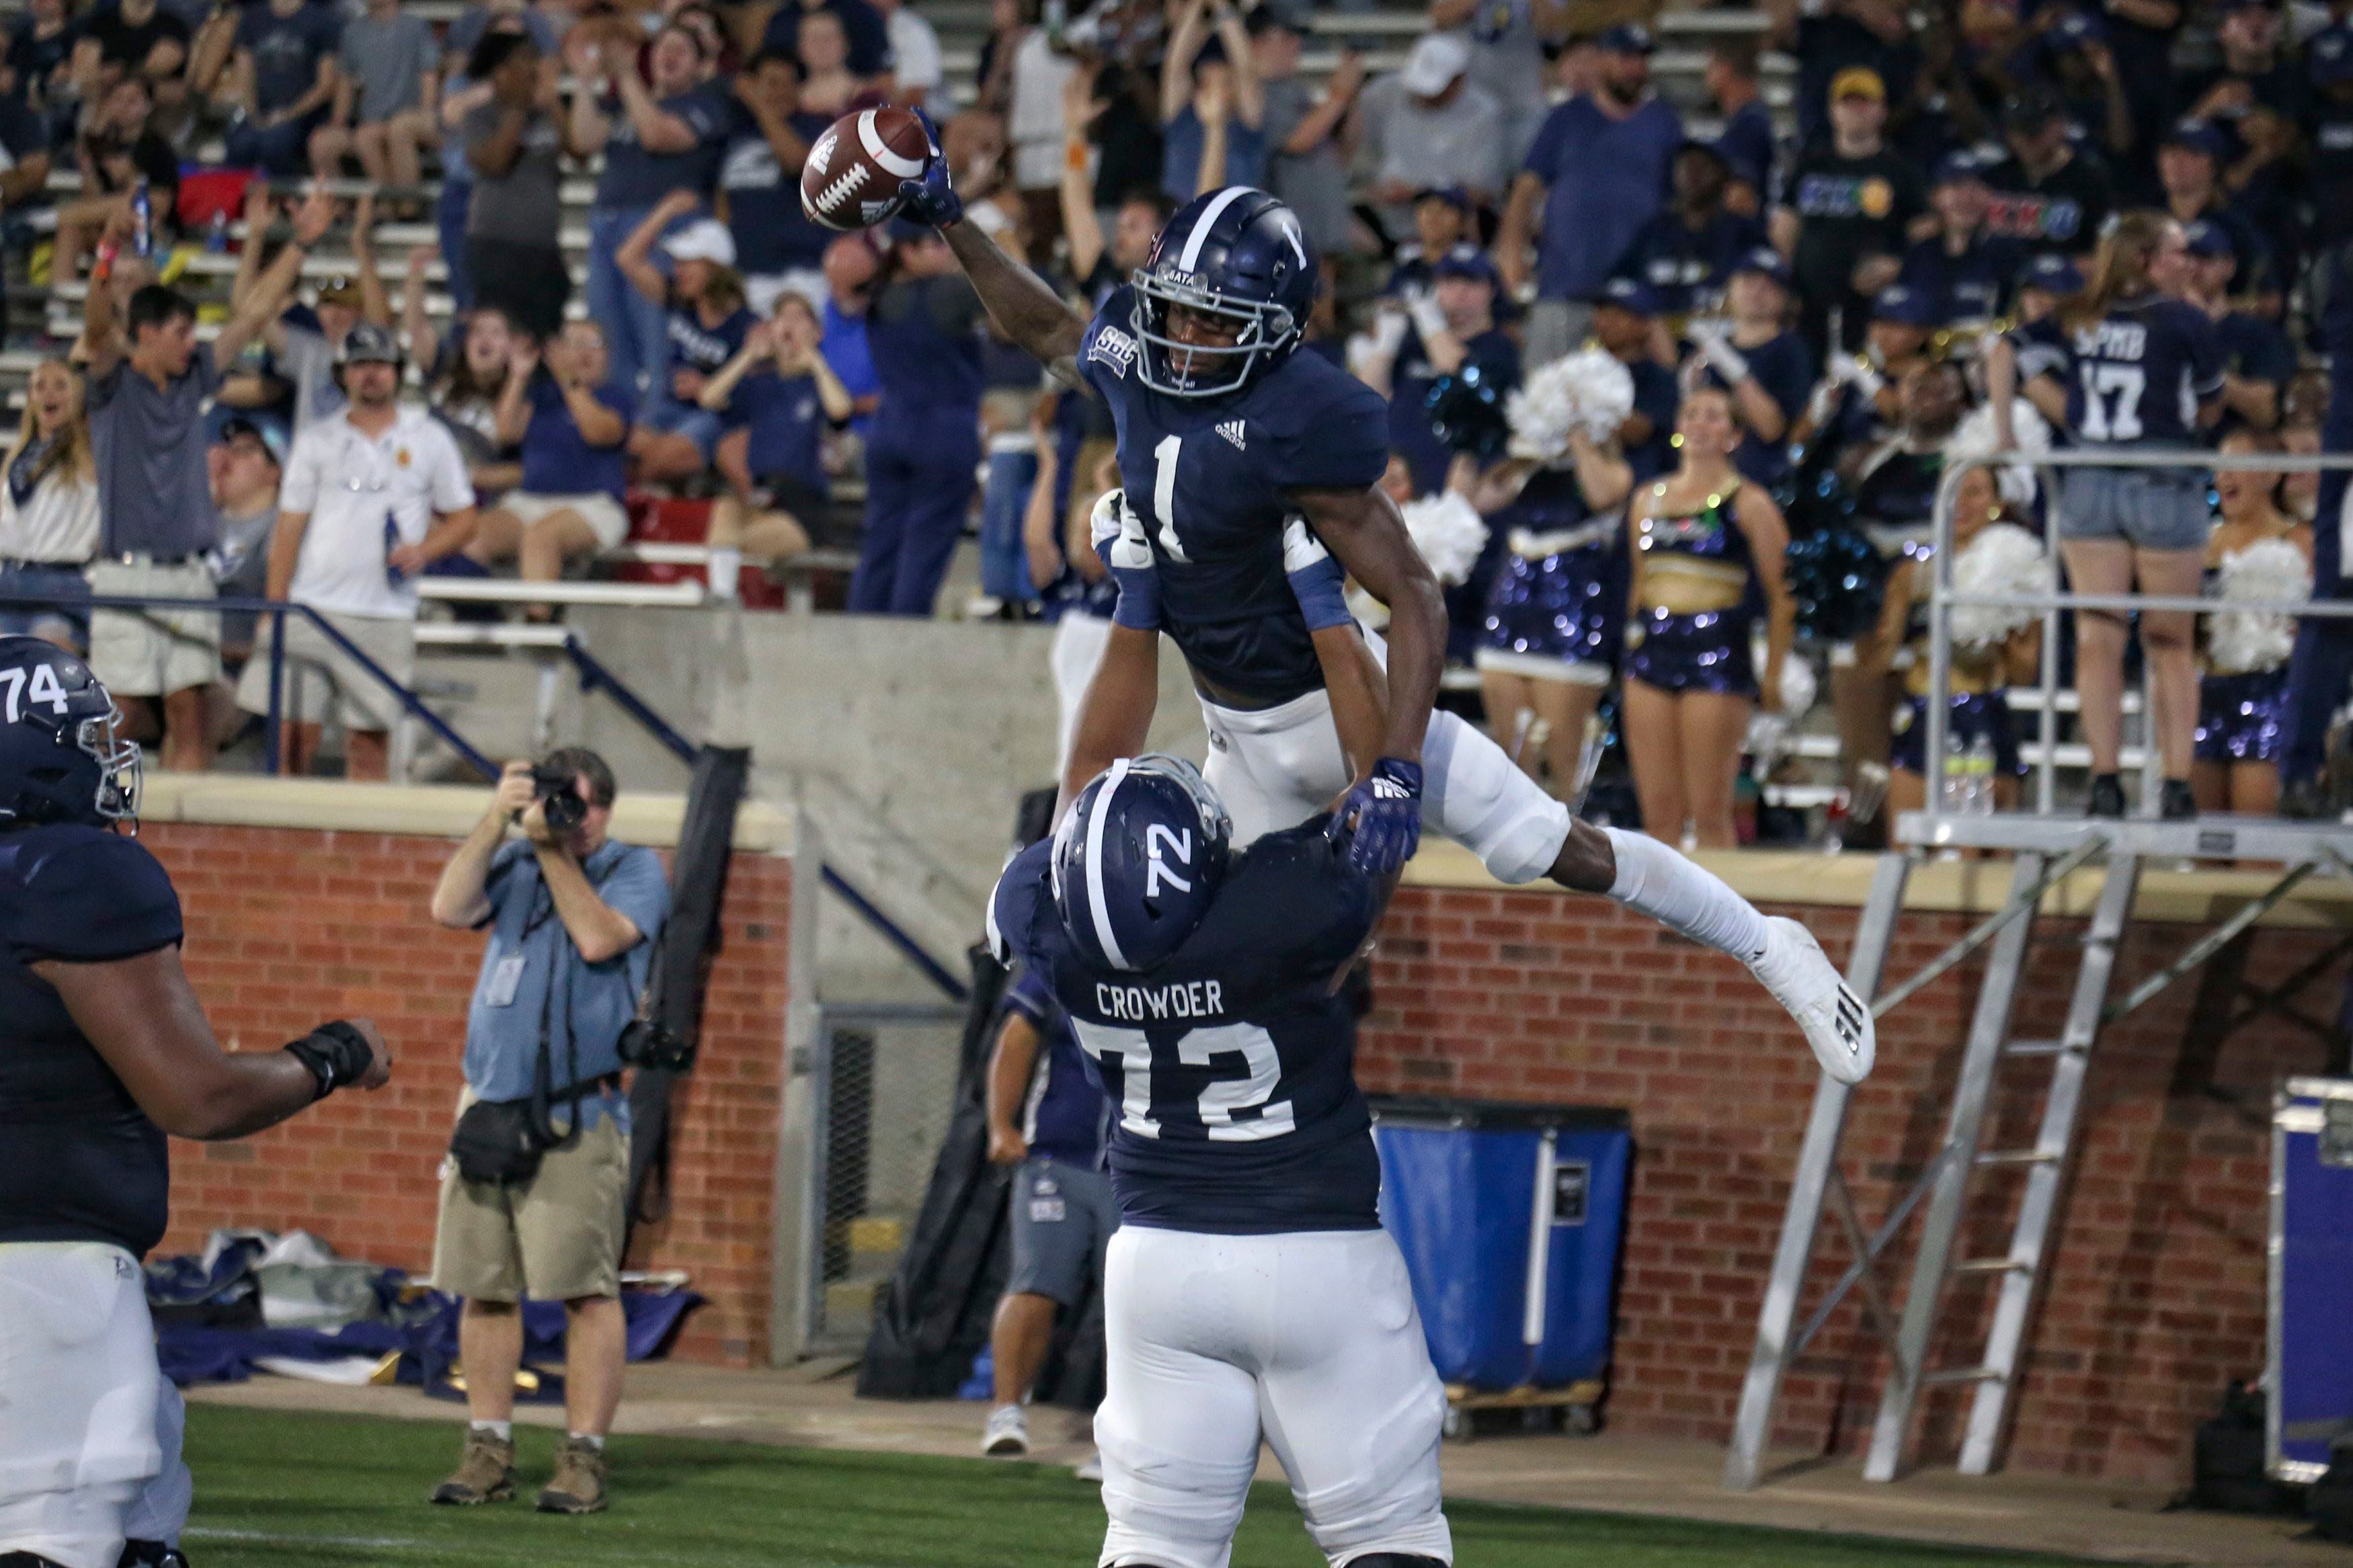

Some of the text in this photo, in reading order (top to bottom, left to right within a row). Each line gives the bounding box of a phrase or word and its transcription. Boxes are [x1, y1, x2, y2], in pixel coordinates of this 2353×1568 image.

[2081, 359, 2146, 441] 17
[1215, 423, 1246, 452] adidas
[1154, 434, 1195, 564] 1
[0, 663, 69, 725] 74
[1146, 823, 1191, 897] 72
[1096, 979, 1224, 1022] CROWDER
[1070, 1015, 1296, 1142] 72
